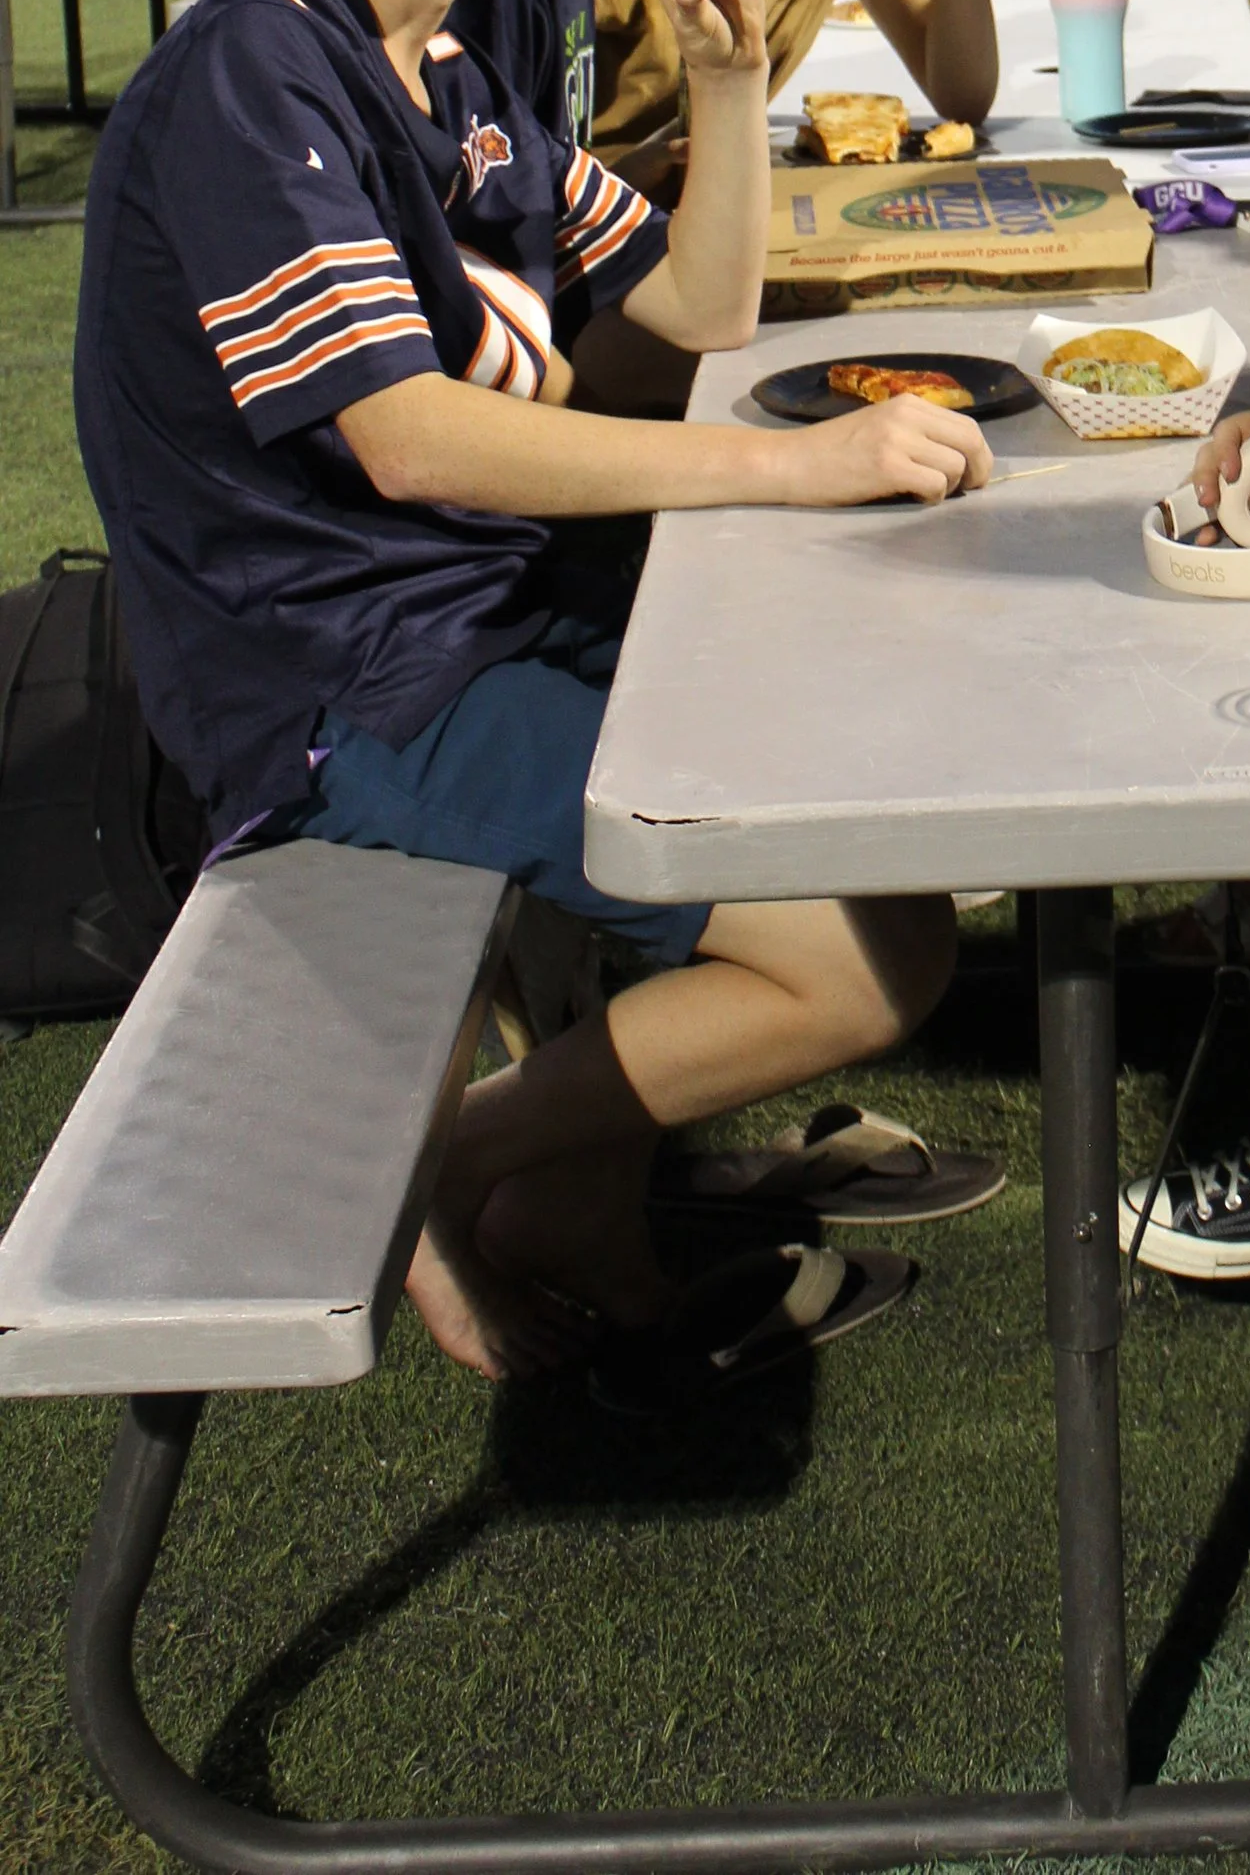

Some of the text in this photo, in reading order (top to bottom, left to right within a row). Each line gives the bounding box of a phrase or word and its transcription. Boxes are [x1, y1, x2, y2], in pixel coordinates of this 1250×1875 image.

[1154, 180, 1204, 211] GCU
[790, 255, 846, 267] Because
[850, 253, 872, 264] the
[875, 251, 910, 264] large
[913, 250, 937, 261] just
[941, 246, 983, 259] wasn't
[986, 247, 1029, 259] gonna
[1033, 245, 1054, 255] cut
[1169, 555, 1225, 583] beats
